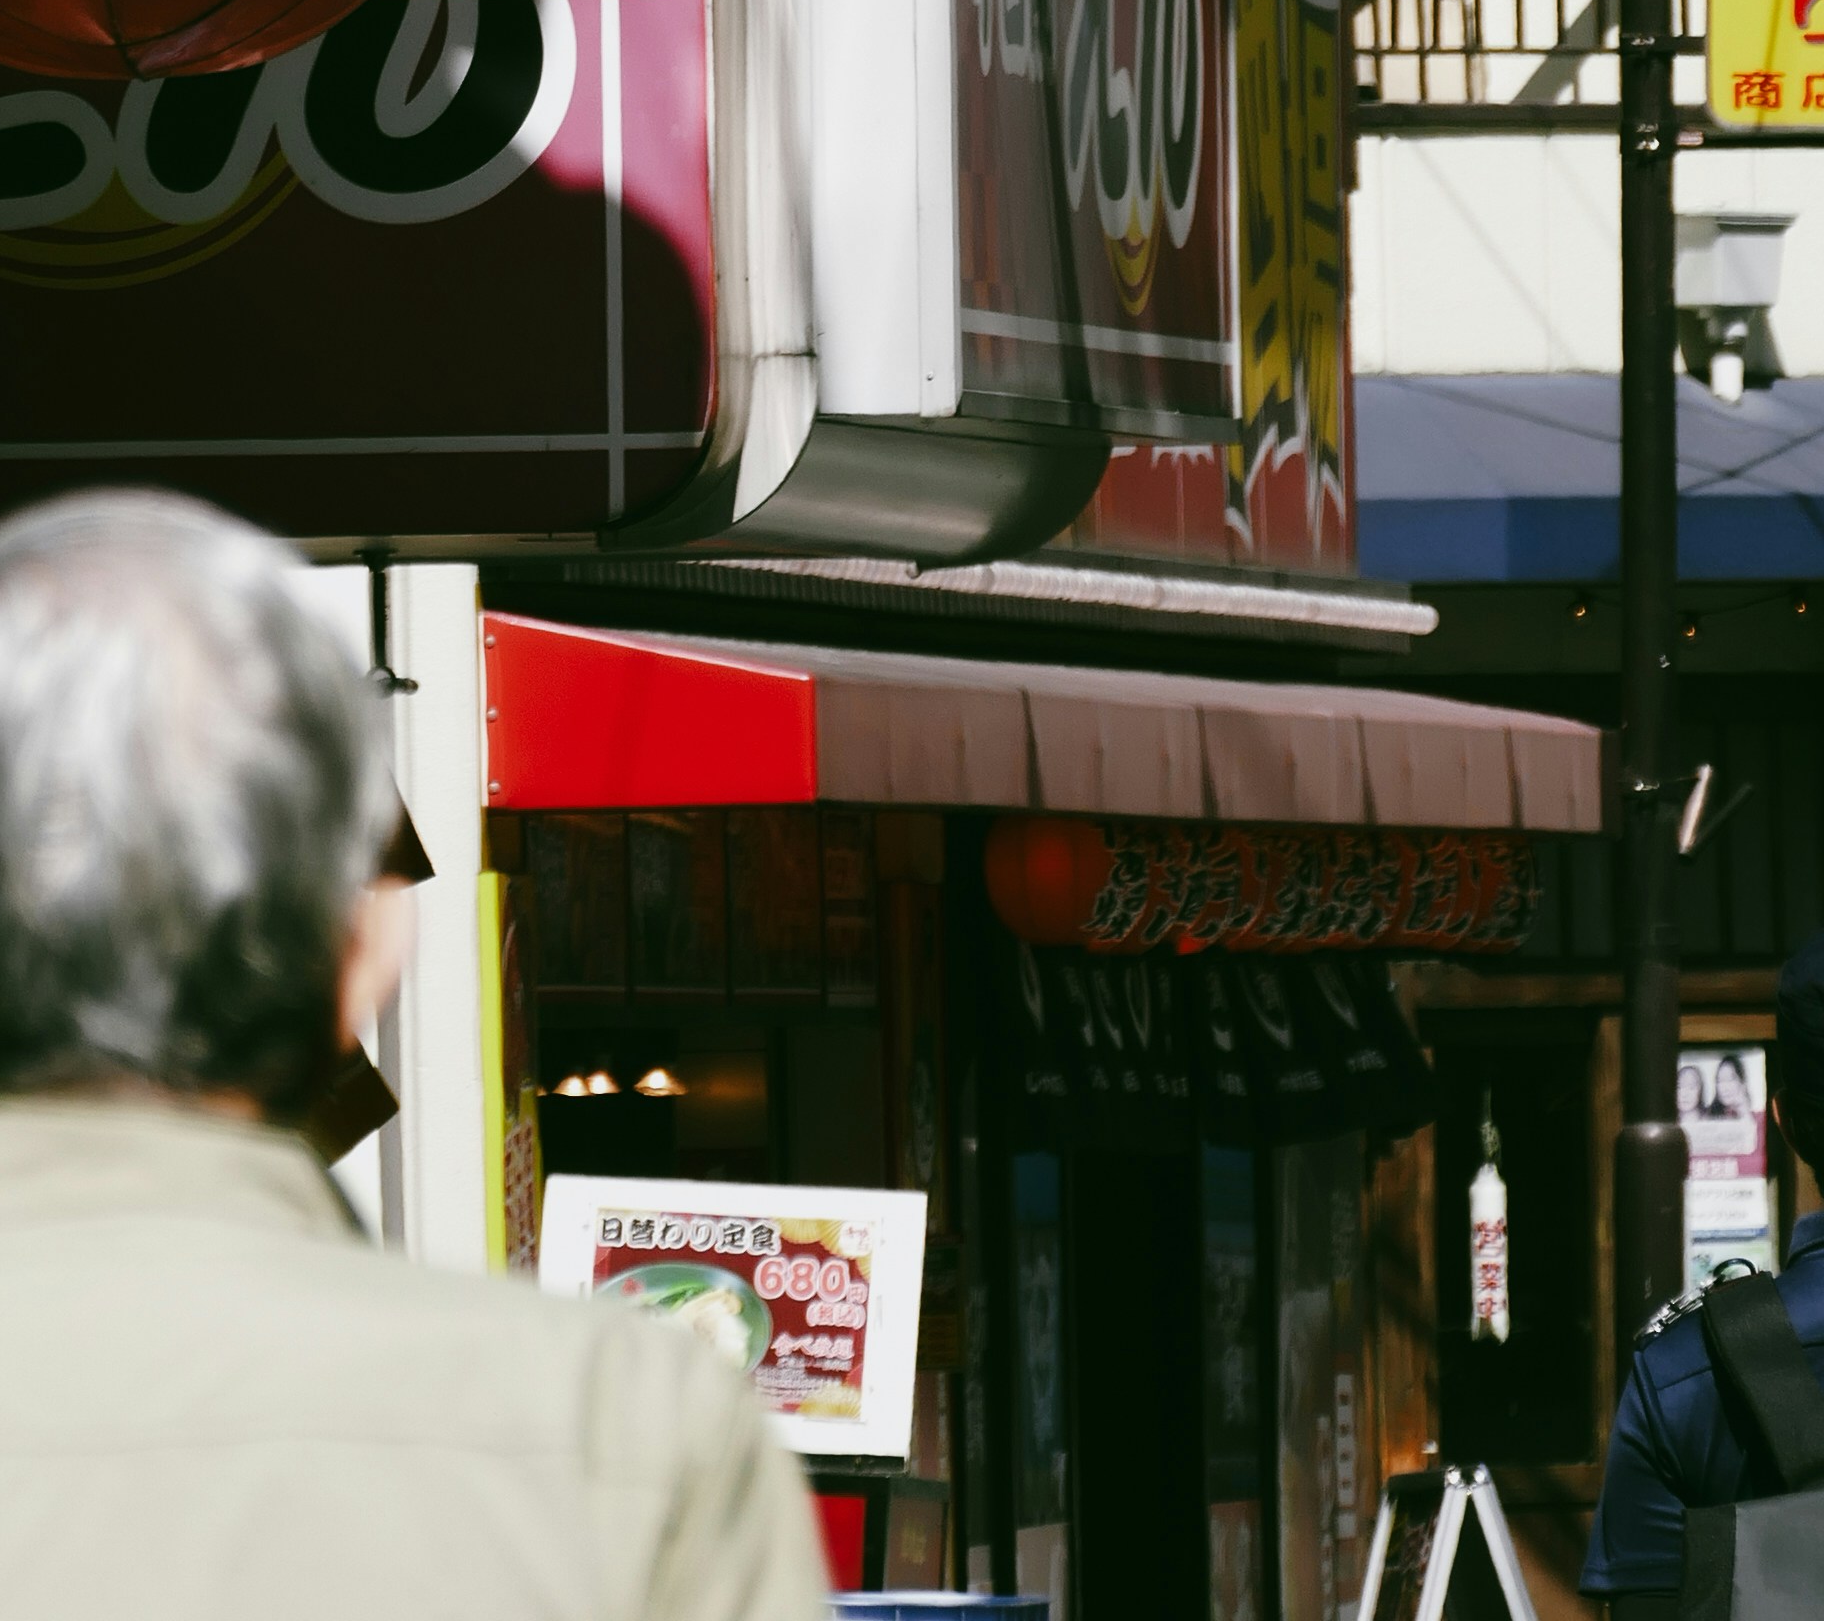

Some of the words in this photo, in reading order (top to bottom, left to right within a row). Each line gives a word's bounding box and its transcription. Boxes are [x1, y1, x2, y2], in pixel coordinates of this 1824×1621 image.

[601, 1216, 778, 1252] 日替わり定食
